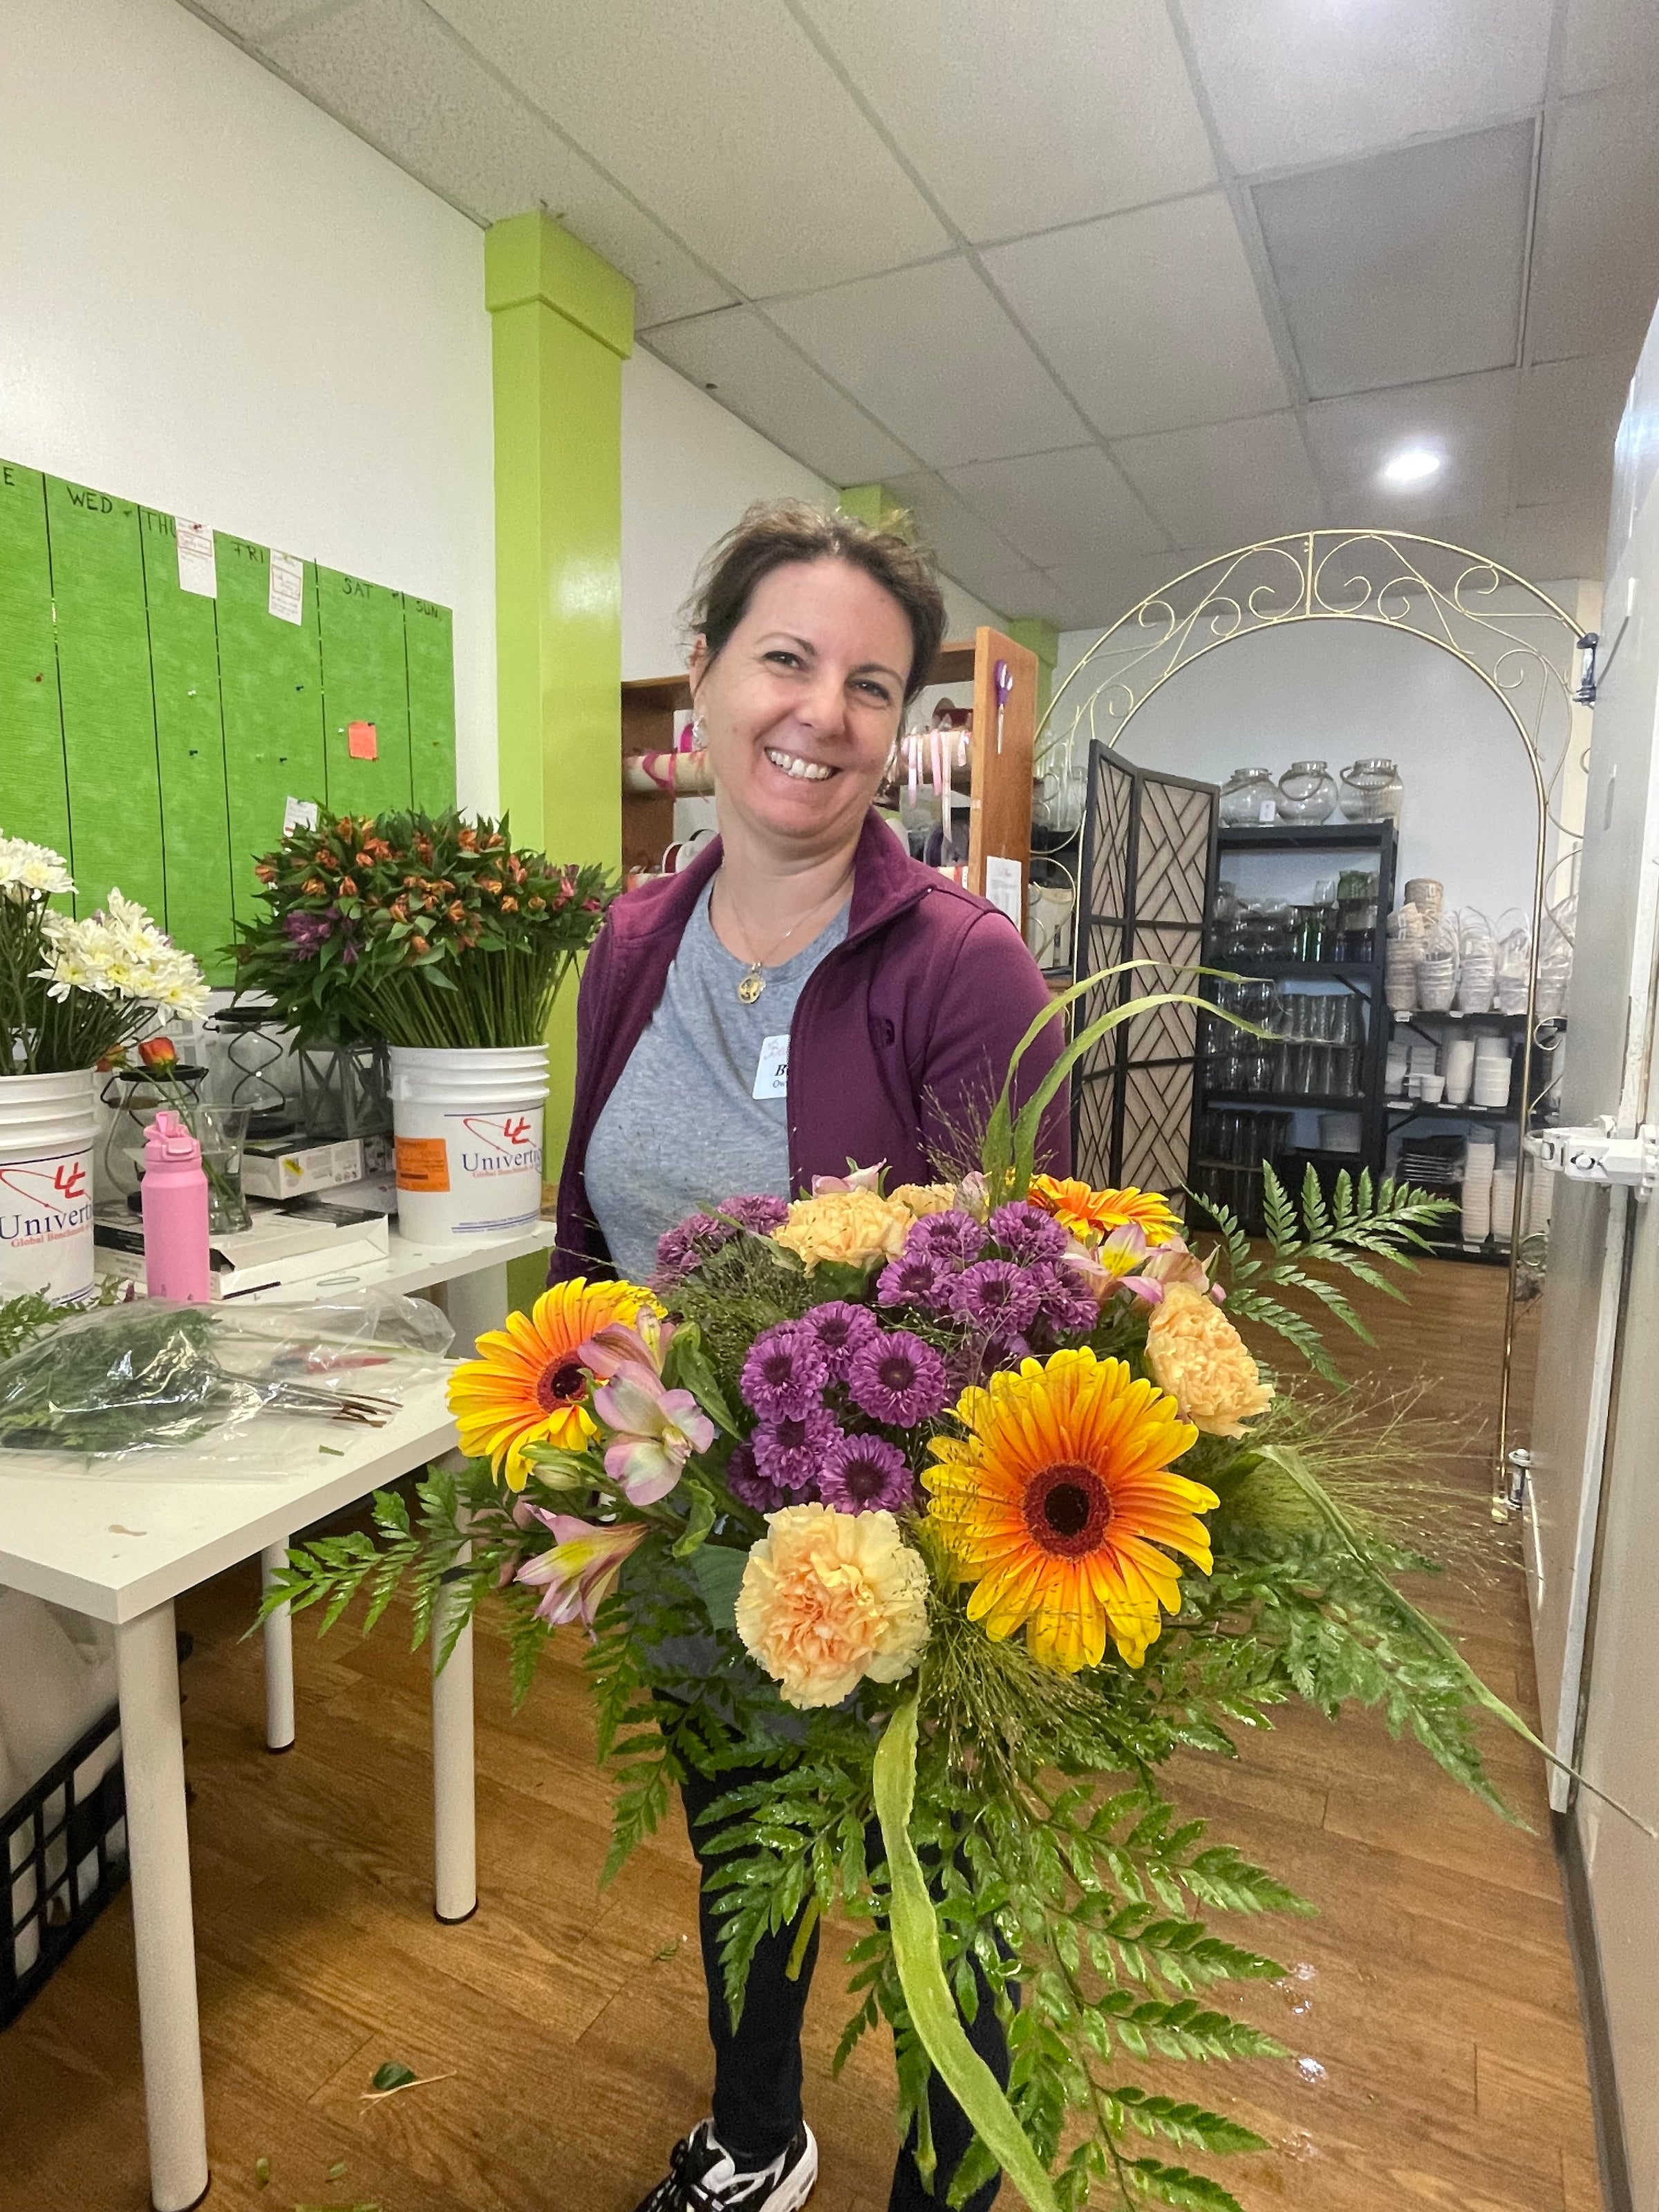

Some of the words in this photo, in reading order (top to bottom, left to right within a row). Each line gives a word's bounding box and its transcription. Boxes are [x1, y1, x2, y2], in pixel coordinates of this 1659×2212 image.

[66, 485, 113, 514] WED
[231, 540, 264, 563] FRI
[342, 577, 374, 599] SAT
